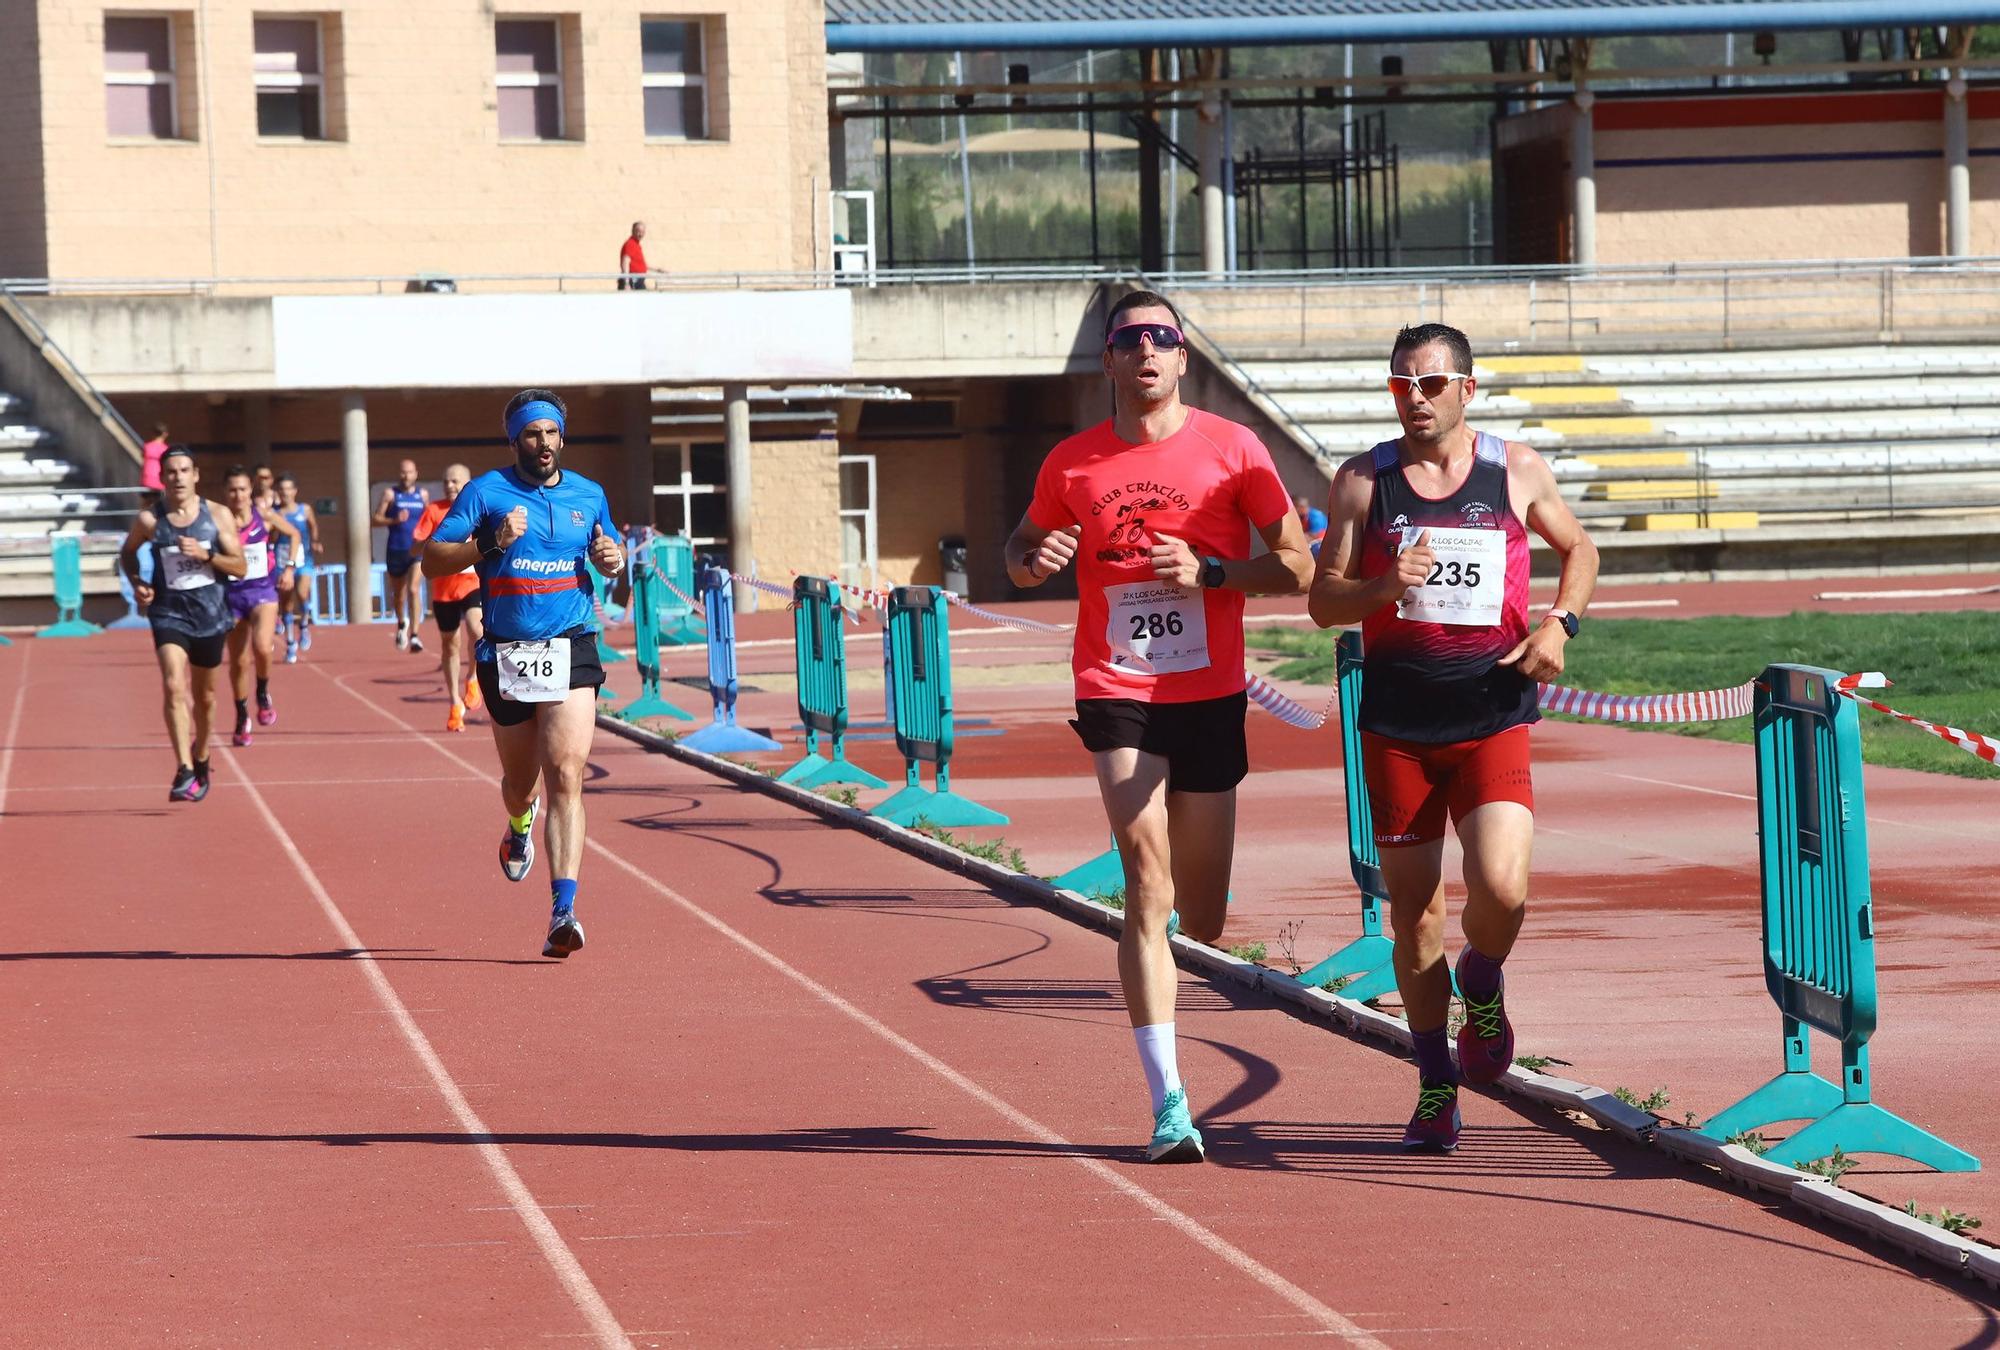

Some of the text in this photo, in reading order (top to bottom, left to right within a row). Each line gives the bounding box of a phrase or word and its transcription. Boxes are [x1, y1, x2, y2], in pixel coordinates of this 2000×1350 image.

[1091, 480, 1190, 516] CLUB TRIATLÓN
[1437, 537, 1452, 545] LOS
[511, 557, 576, 575] enerplus
[1426, 561, 1481, 588] 235
[1135, 590, 1149, 599] LOS
[1149, 587, 1180, 598] CALIFAS
[1129, 610, 1184, 641] 286
[516, 660, 553, 677] 218
